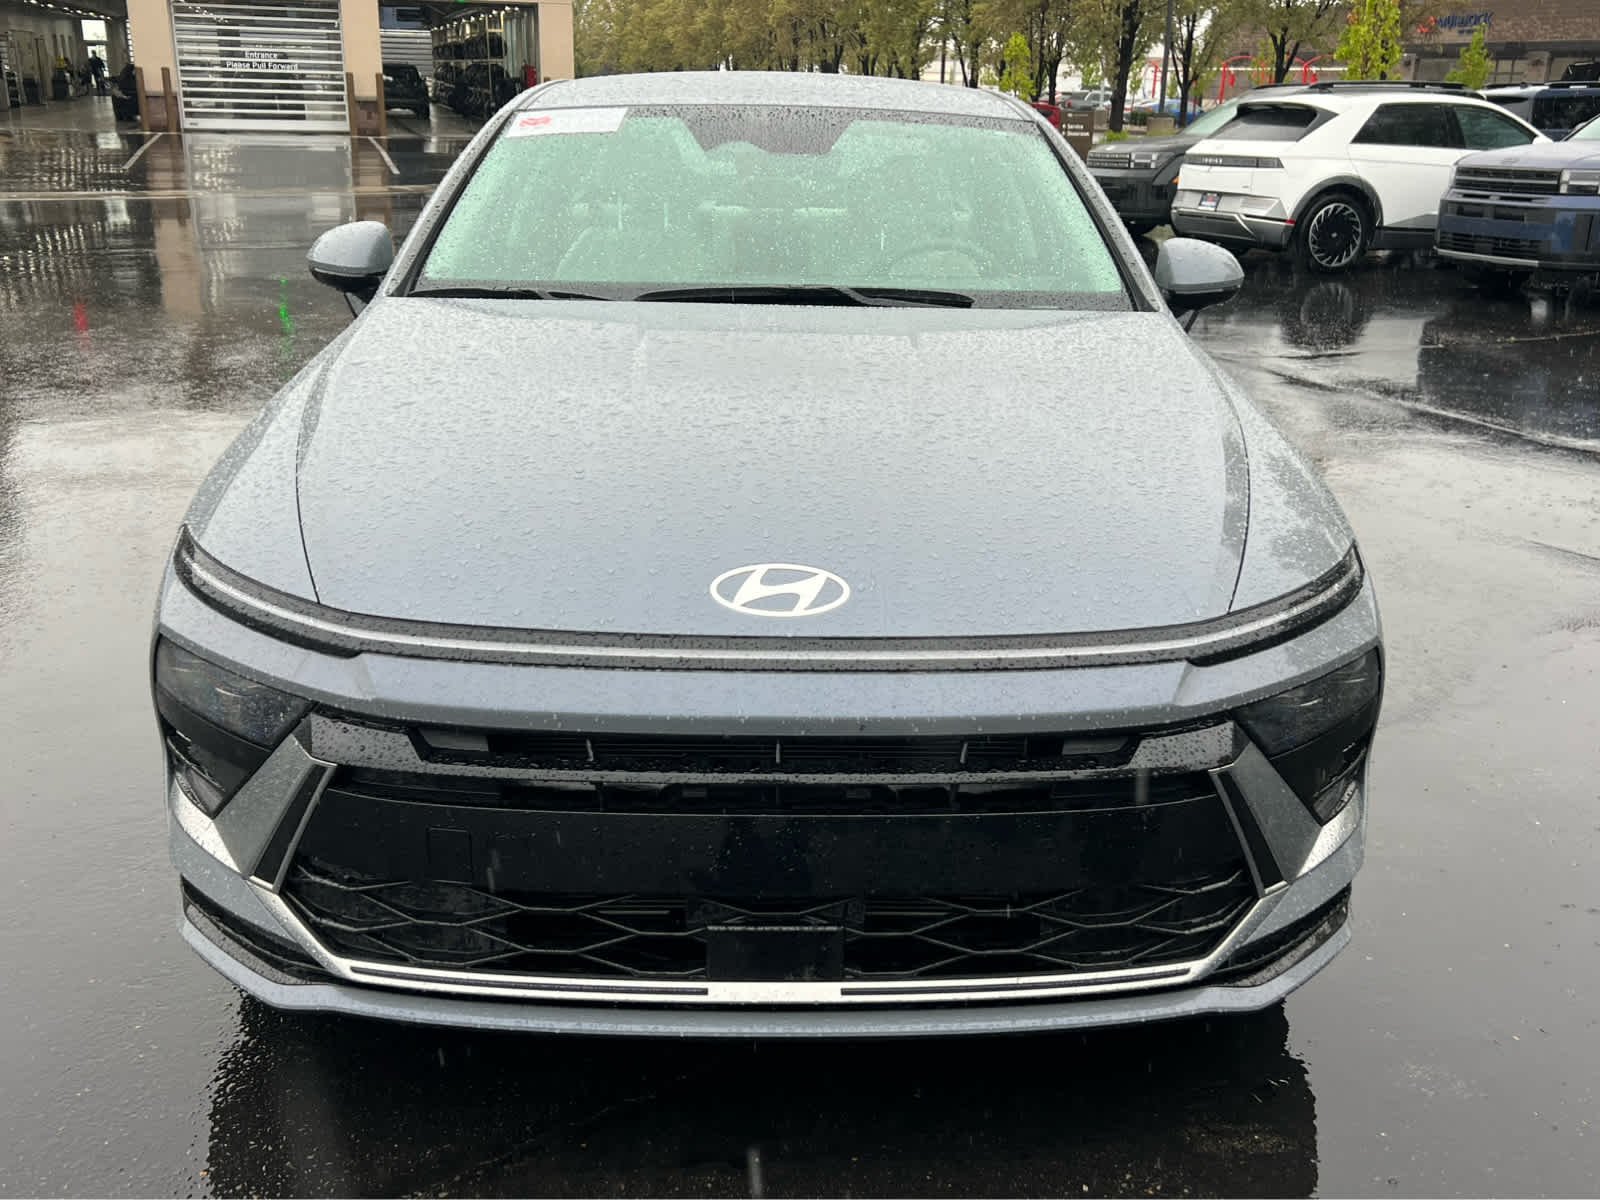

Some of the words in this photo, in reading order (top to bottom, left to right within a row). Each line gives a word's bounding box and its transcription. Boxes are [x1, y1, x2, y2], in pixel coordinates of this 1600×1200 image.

[244, 51, 278, 59] Entrance
[226, 61, 251, 69] Please
[252, 62, 267, 70] Pull
[268, 63, 298, 71] Forward
